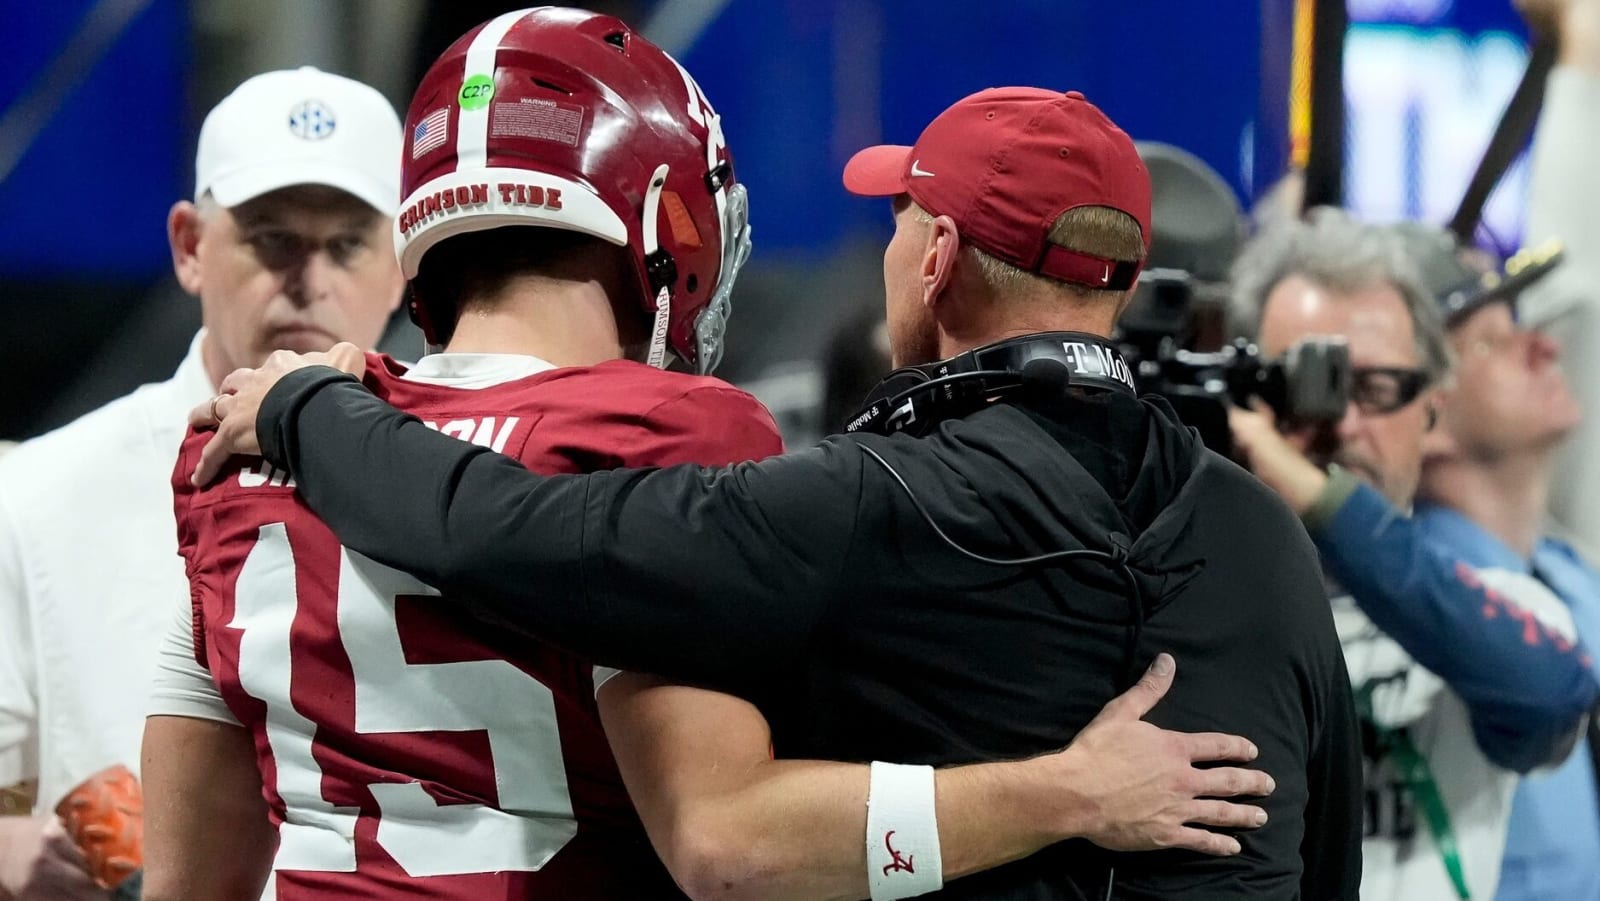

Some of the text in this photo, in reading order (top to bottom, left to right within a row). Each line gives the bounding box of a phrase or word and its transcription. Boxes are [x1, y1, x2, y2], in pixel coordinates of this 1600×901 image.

[462, 84, 491, 99] C2P
[520, 98, 557, 108] WARNING
[399, 183, 563, 235] CRIMSON TIDE
[655, 289, 668, 345] RIMSON
[1091, 344, 1137, 395] Mob
[846, 410, 872, 432] Mobile
[225, 522, 578, 877] 15
